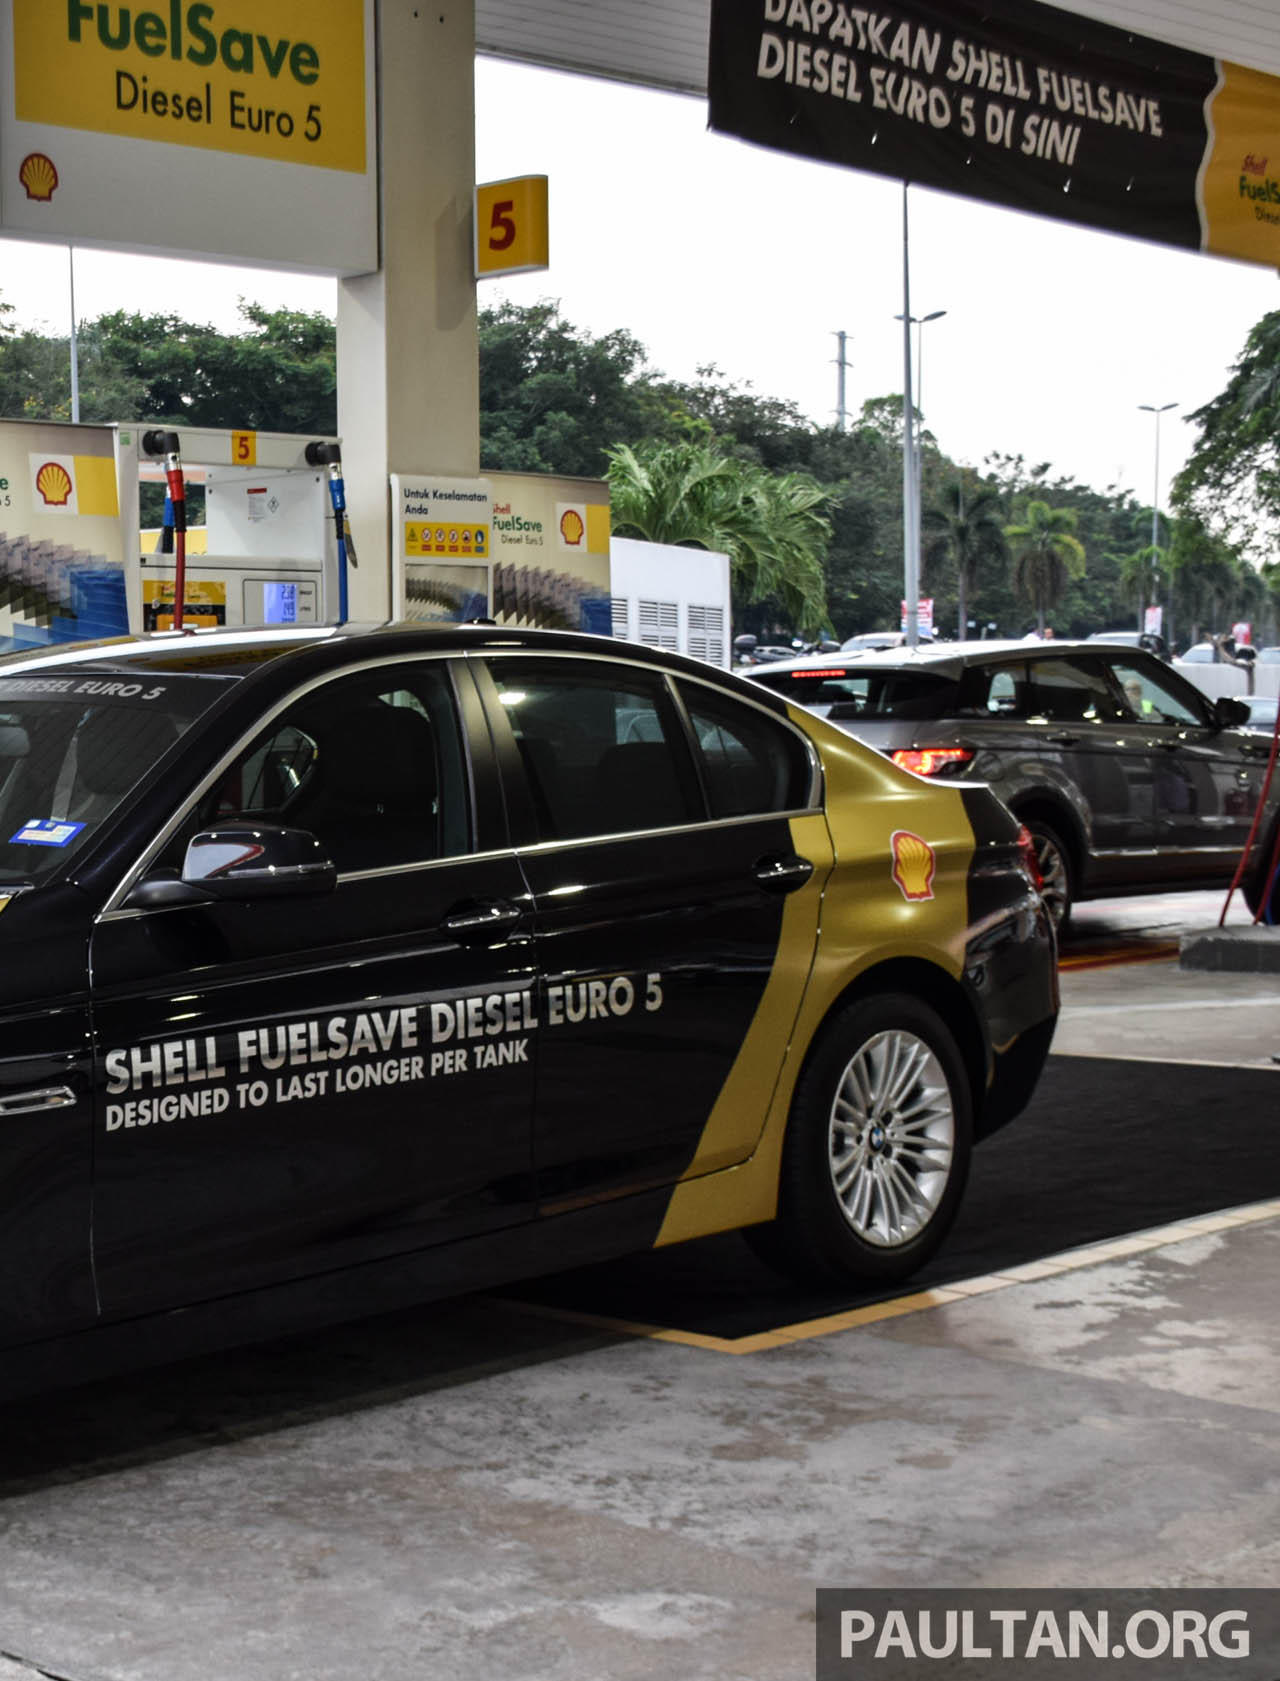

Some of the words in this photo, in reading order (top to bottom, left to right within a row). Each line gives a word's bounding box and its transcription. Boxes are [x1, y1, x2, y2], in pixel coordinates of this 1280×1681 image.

[67, 0, 320, 86] FuelSave
[765, 0, 941, 74] DAPATKAN
[946, 39, 1031, 100] SHELL
[1036, 66, 1163, 138] FUELSAVE
[115, 69, 212, 125] Diesel
[230, 90, 295, 138] Euro
[304, 104, 322, 142] 5
[757, 32, 862, 103] DIESEL
[870, 66, 951, 128] EURO
[960, 96, 976, 137] 5
[985, 104, 1015, 149] DI
[1021, 114, 1081, 166] SINI
[489, 201, 515, 250] 5
[238, 436, 250, 460] 5
[4, 495, 11, 506] 5
[404, 488, 429, 499] Untuk
[432, 490, 487, 502] Keselamatan
[405, 504, 428, 515] Anda
[501, 534, 523, 545] Diesel
[74, 682, 140, 698] EURO
[142, 686, 167, 700] 5
[105, 1036, 226, 1095] SHELL
[237, 1006, 418, 1074] FUELSAVE
[430, 990, 539, 1044] DIESEL
[547, 976, 635, 1026] EURO
[645, 972, 663, 1012] 5
[106, 1087, 230, 1132] DESIGNED
[236, 1080, 269, 1109] TO
[276, 1071, 330, 1103] LAST
[335, 1055, 424, 1093] LONGER
[431, 1048, 468, 1077] PER
[473, 1038, 529, 1070] TANK
